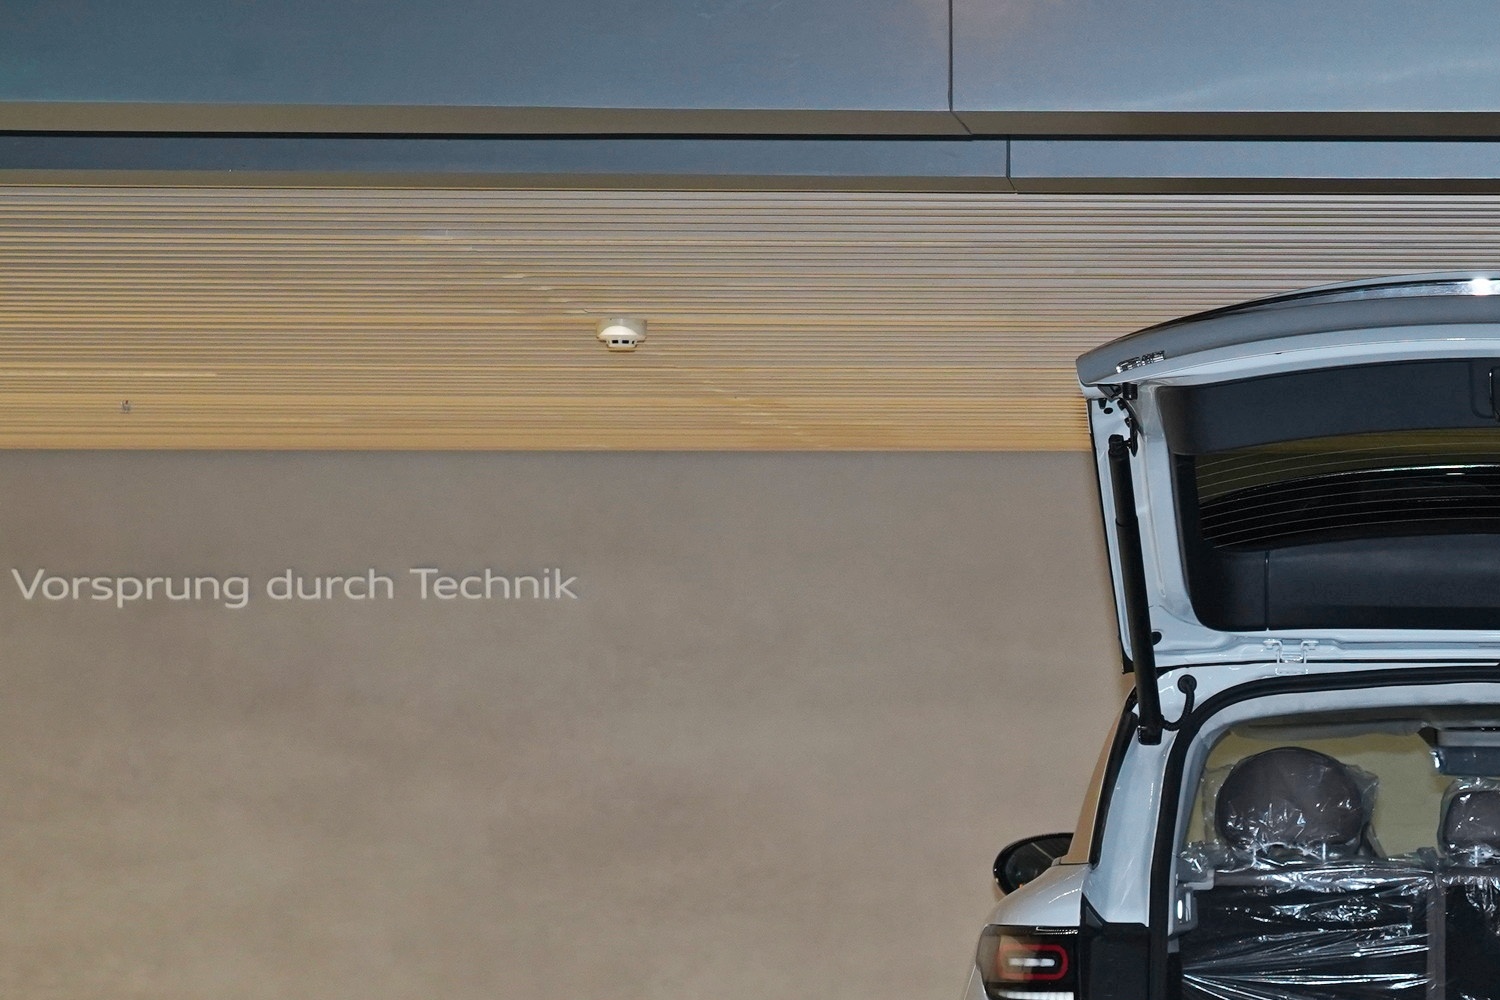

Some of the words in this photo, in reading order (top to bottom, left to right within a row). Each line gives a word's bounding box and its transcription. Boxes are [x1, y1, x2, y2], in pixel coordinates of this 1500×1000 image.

[10, 568, 249, 608] Vorsprung
[266, 568, 394, 600] durch
[409, 568, 579, 600] Technik
